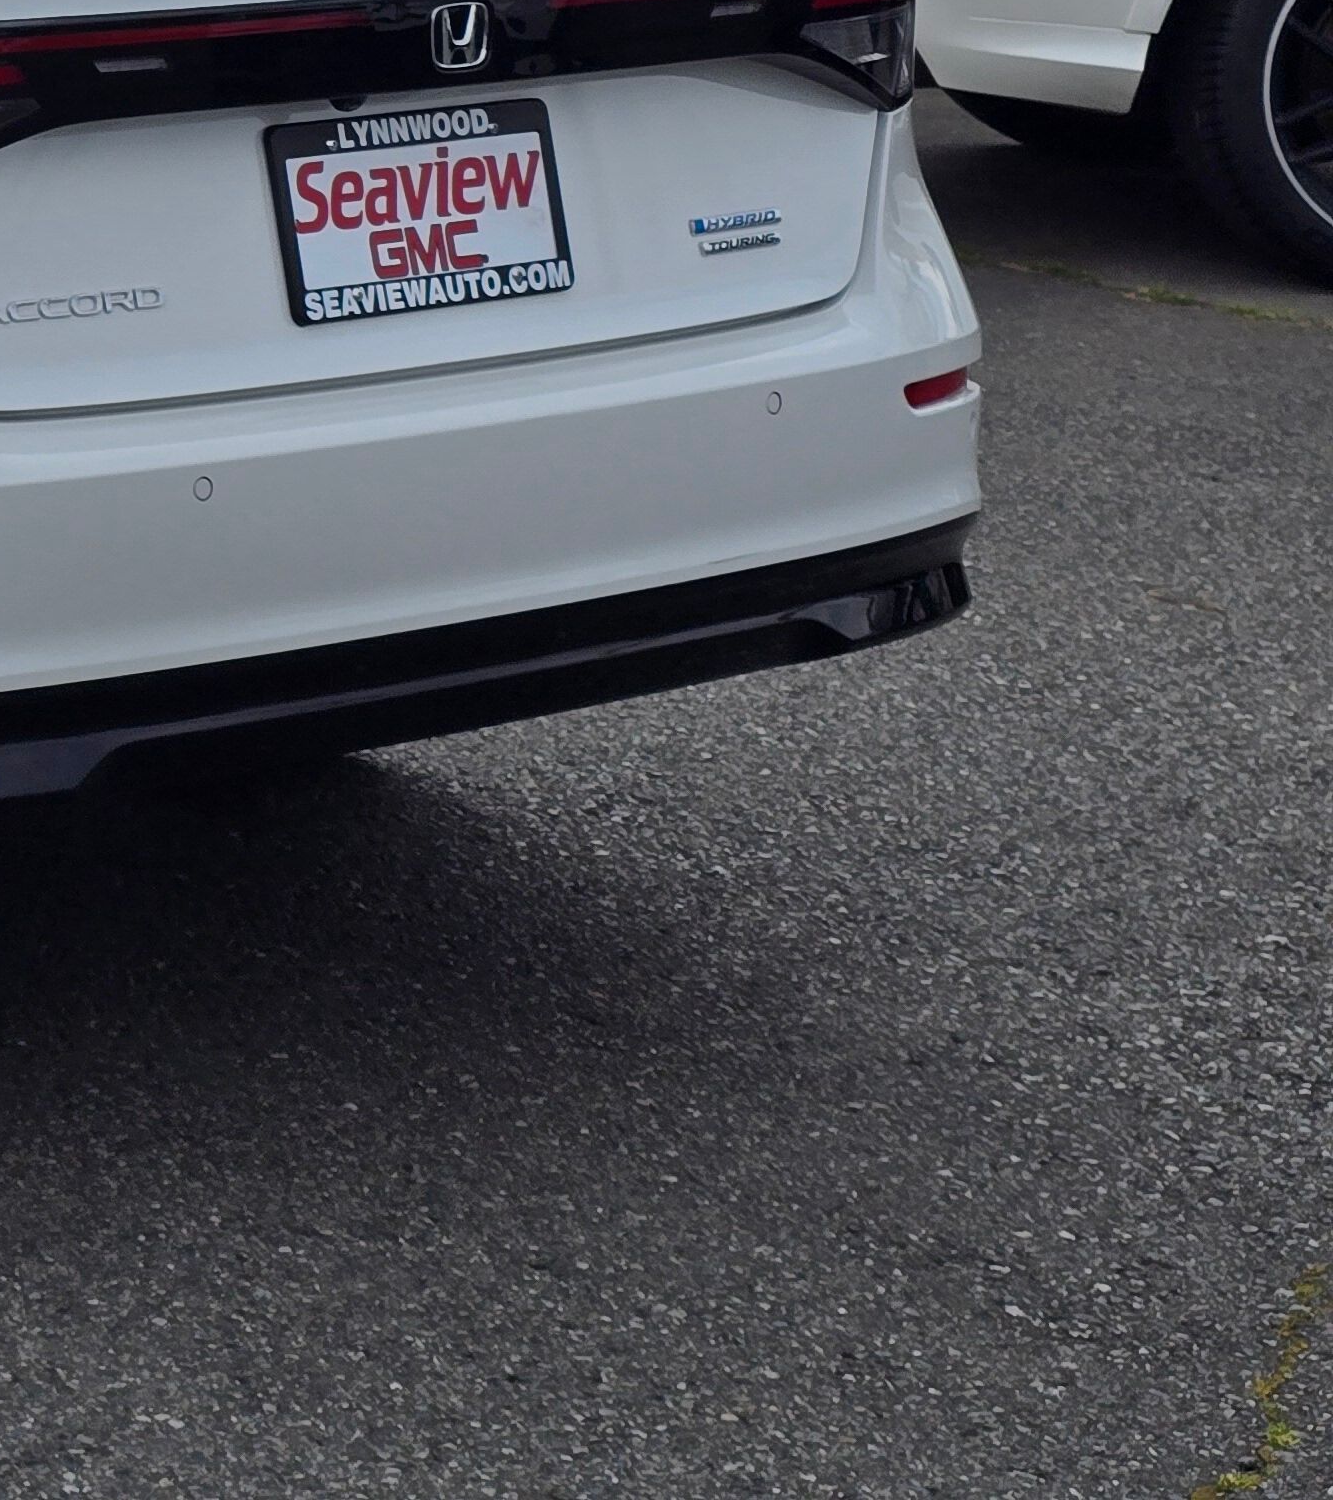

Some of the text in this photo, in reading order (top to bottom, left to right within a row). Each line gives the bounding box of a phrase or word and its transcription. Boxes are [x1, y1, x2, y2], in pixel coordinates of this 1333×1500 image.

[337, 108, 491, 150] LYNNWOOD
[295, 146, 541, 235] Seaview
[704, 209, 777, 233] HYBRID
[707, 232, 779, 255] TOURING
[368, 218, 490, 280] GMC
[304, 259, 572, 321] SEAVIEWAUTO.COM
